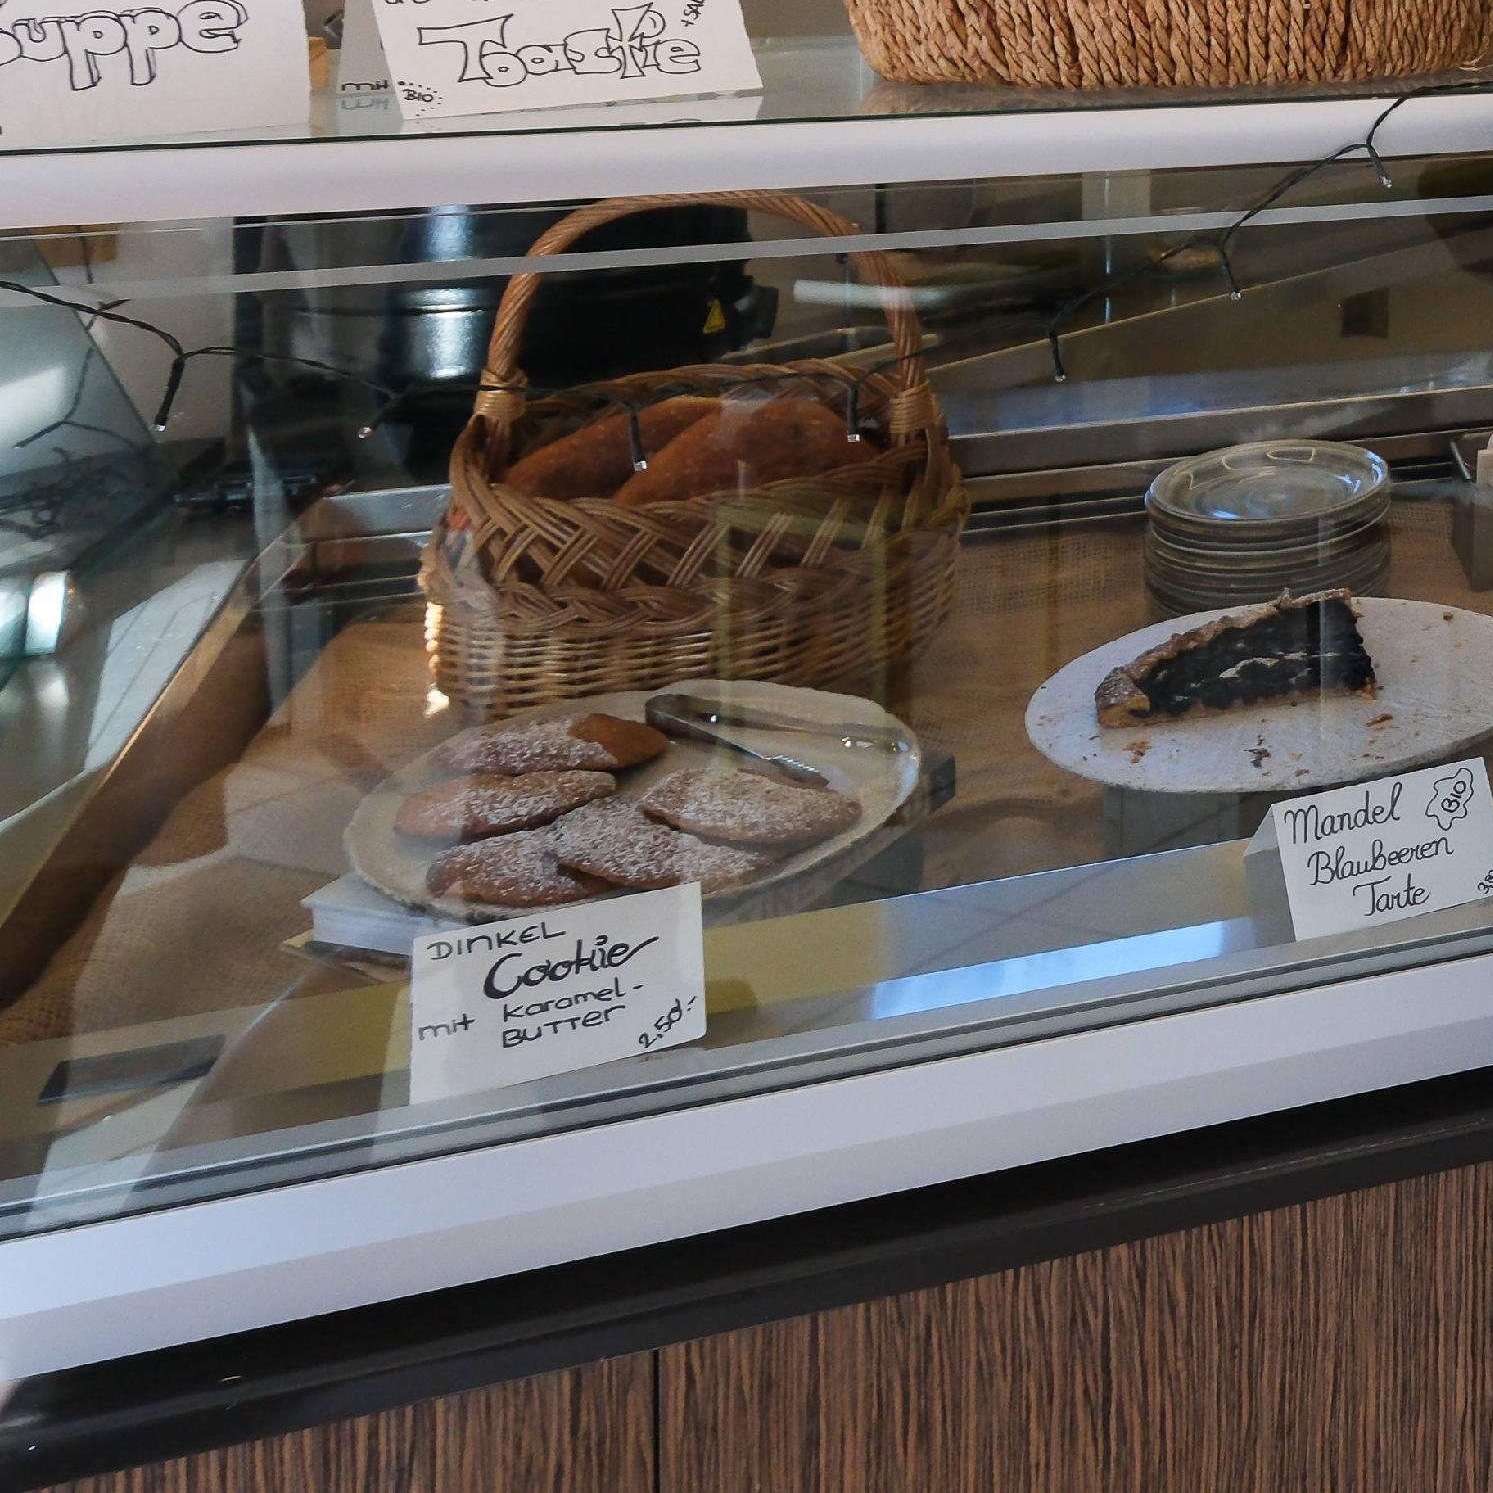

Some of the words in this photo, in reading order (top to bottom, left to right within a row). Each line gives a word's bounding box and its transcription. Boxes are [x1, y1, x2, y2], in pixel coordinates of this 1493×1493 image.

[417, 2, 702, 88] Toastie
[402, 88, 434, 103] BIO
[1284, 781, 1403, 845] Mandel
[1441, 780, 1467, 814] BIO
[1353, 873, 1430, 917] Tarte
[483, 934, 660, 999] Cookie
[418, 1013, 476, 1041] mit
